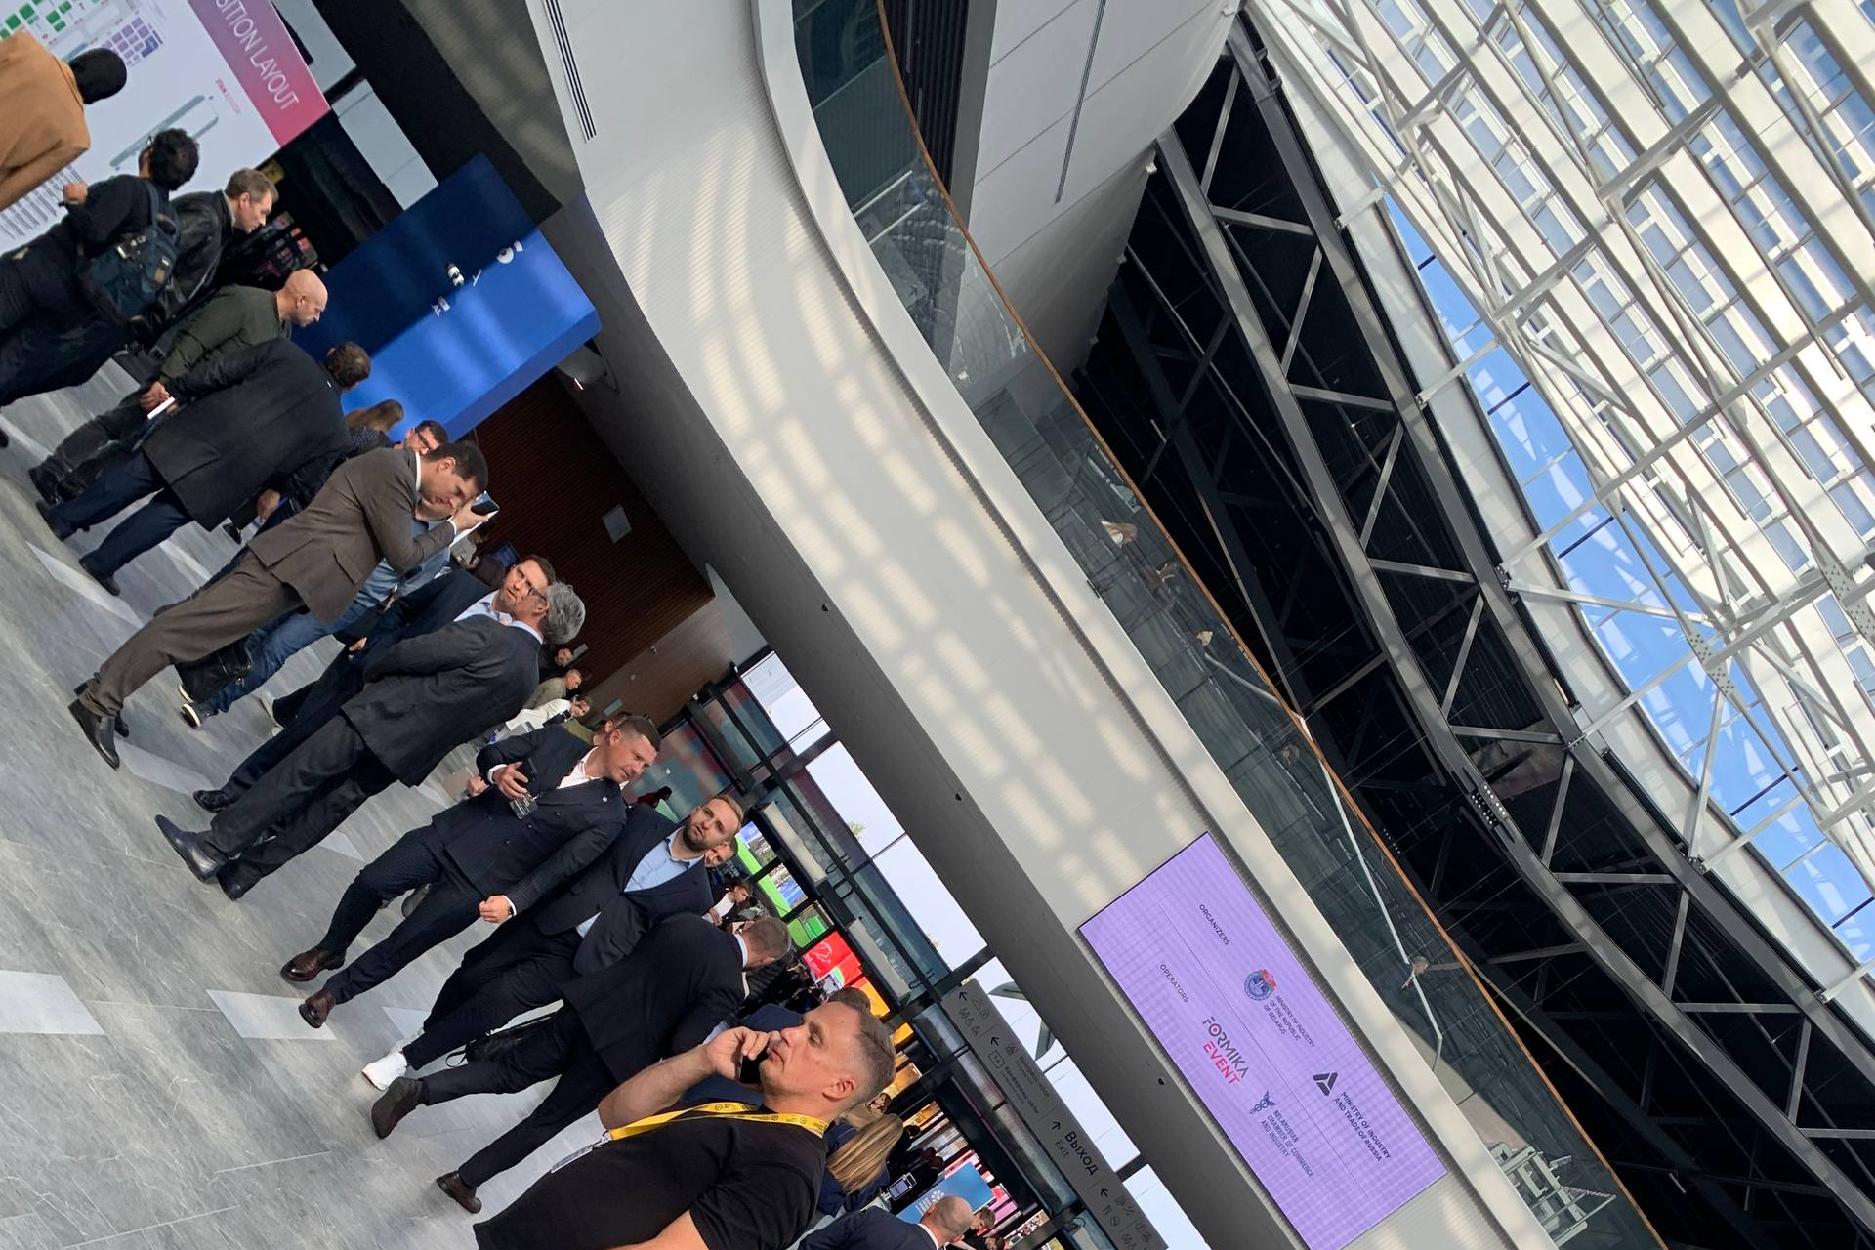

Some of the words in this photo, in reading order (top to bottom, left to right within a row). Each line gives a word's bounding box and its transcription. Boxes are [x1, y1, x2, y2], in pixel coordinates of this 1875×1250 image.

[250, 46, 299, 111] LAYOUT
[1197, 903, 1231, 946] ORGANIZERS
[1158, 963, 1190, 1003] OPERATORS
[1273, 1006, 1284, 1019] THE
[1201, 1015, 1251, 1079] FORMIKA
[1295, 1023, 1315, 1048] INDUSTRY
[1201, 1040, 1239, 1087] EVENT
[1260, 1119, 1271, 1132] AND
[1268, 1131, 1289, 1158] INDUSTRY
[1266, 1114, 1287, 1142] CHAMBER
[1289, 1147, 1314, 1178] COMMERCE
[1333, 1097, 1346, 1112] AND
[1343, 1110, 1360, 1131] TRADE
[1356, 1130, 1366, 1140] OF
[1363, 1139, 1382, 1162] RUSSIA
[1340, 1092, 1363, 1122] MINISTRY
[1360, 1120, 1369, 1130] OF
[1366, 1129, 1392, 1160] INDUSTRY
[1053, 1140, 1070, 1159] Exit
